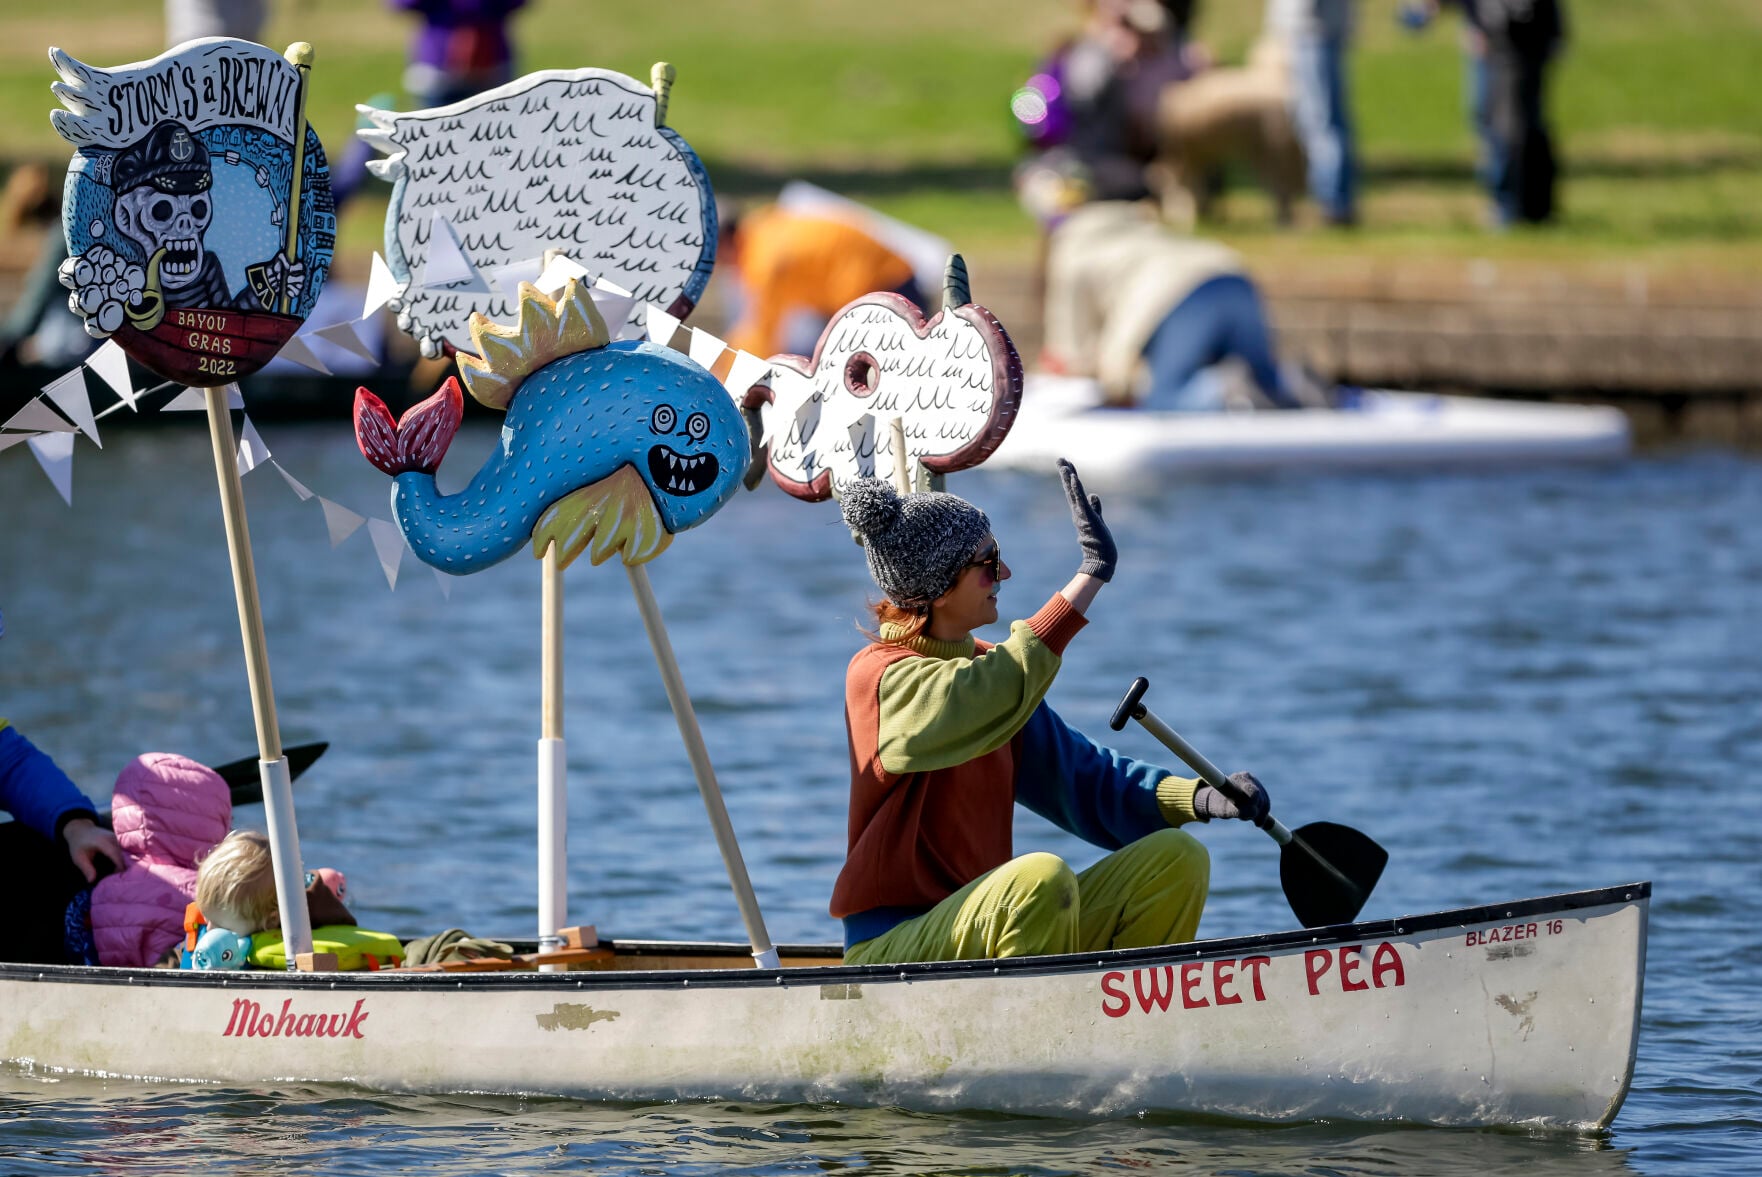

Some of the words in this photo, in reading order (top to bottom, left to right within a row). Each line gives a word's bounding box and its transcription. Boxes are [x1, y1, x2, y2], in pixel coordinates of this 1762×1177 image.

[108, 61, 198, 136] STORM'S
[203, 76, 217, 103] a
[178, 311, 227, 331] BAYOU
[188, 332, 232, 353] GRAS
[198, 357, 237, 375] 2022
[1465, 922, 1538, 947] BLAZER
[1545, 919, 1563, 935] 16
[1101, 955, 1271, 1018] SWEET
[1304, 941, 1405, 996] PEA
[222, 997, 370, 1039] Mohawk
